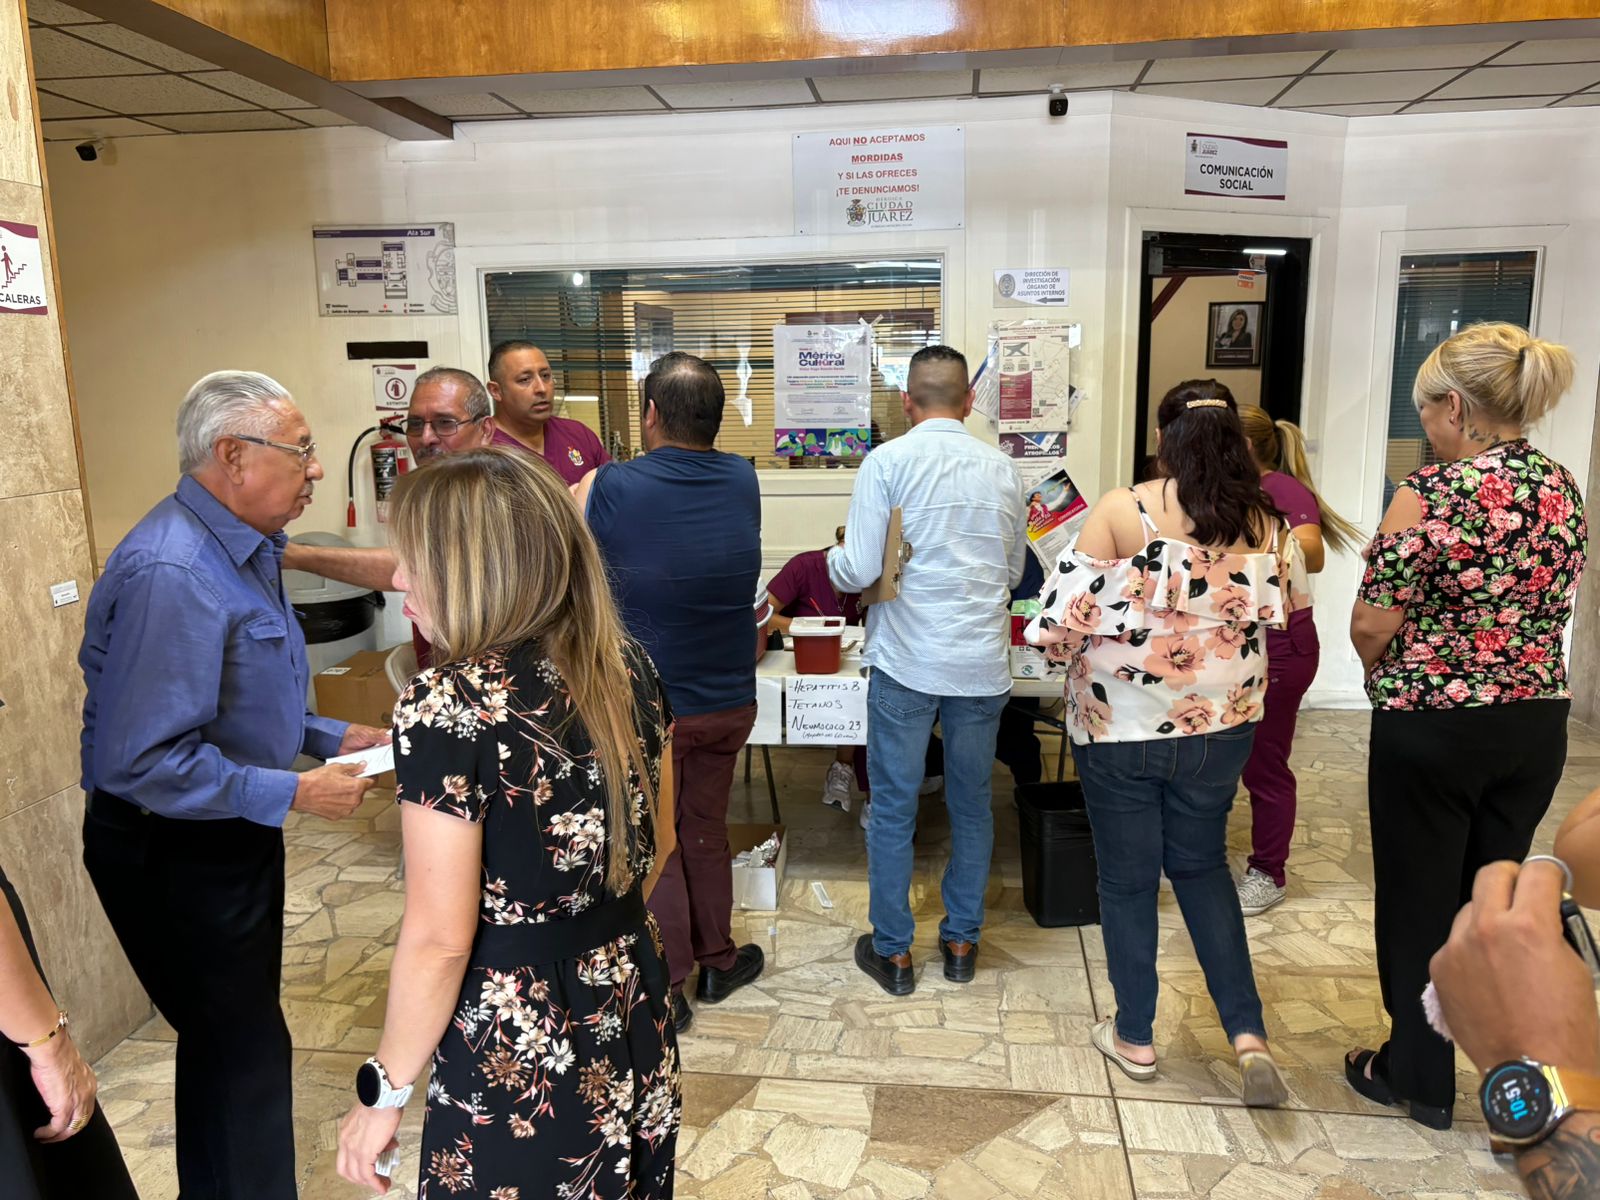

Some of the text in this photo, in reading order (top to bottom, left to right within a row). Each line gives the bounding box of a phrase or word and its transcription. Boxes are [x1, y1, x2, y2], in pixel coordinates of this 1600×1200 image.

[829, 134, 926, 146] AQUI NO ACEPTAMOS
[851, 153, 904, 164] MORDIDAS
[837, 169, 918, 180] Y SI LAS OFRECES
[1200, 163, 1273, 179] COMUNICACIÓN
[1219, 178, 1254, 191] SOCIAL
[836, 184, 920, 197] ¡TE DENUNCIAMOS!
[867, 200, 913, 210] CIUDAD
[406, 229, 419, 237] Ala
[1022, 276, 1061, 284] INVESTIGACIÓN
[799, 351, 842, 359] Mérito
[799, 359, 845, 367] Cultural
[851, 681, 860, 691] B
[848, 720, 861, 731] 23
